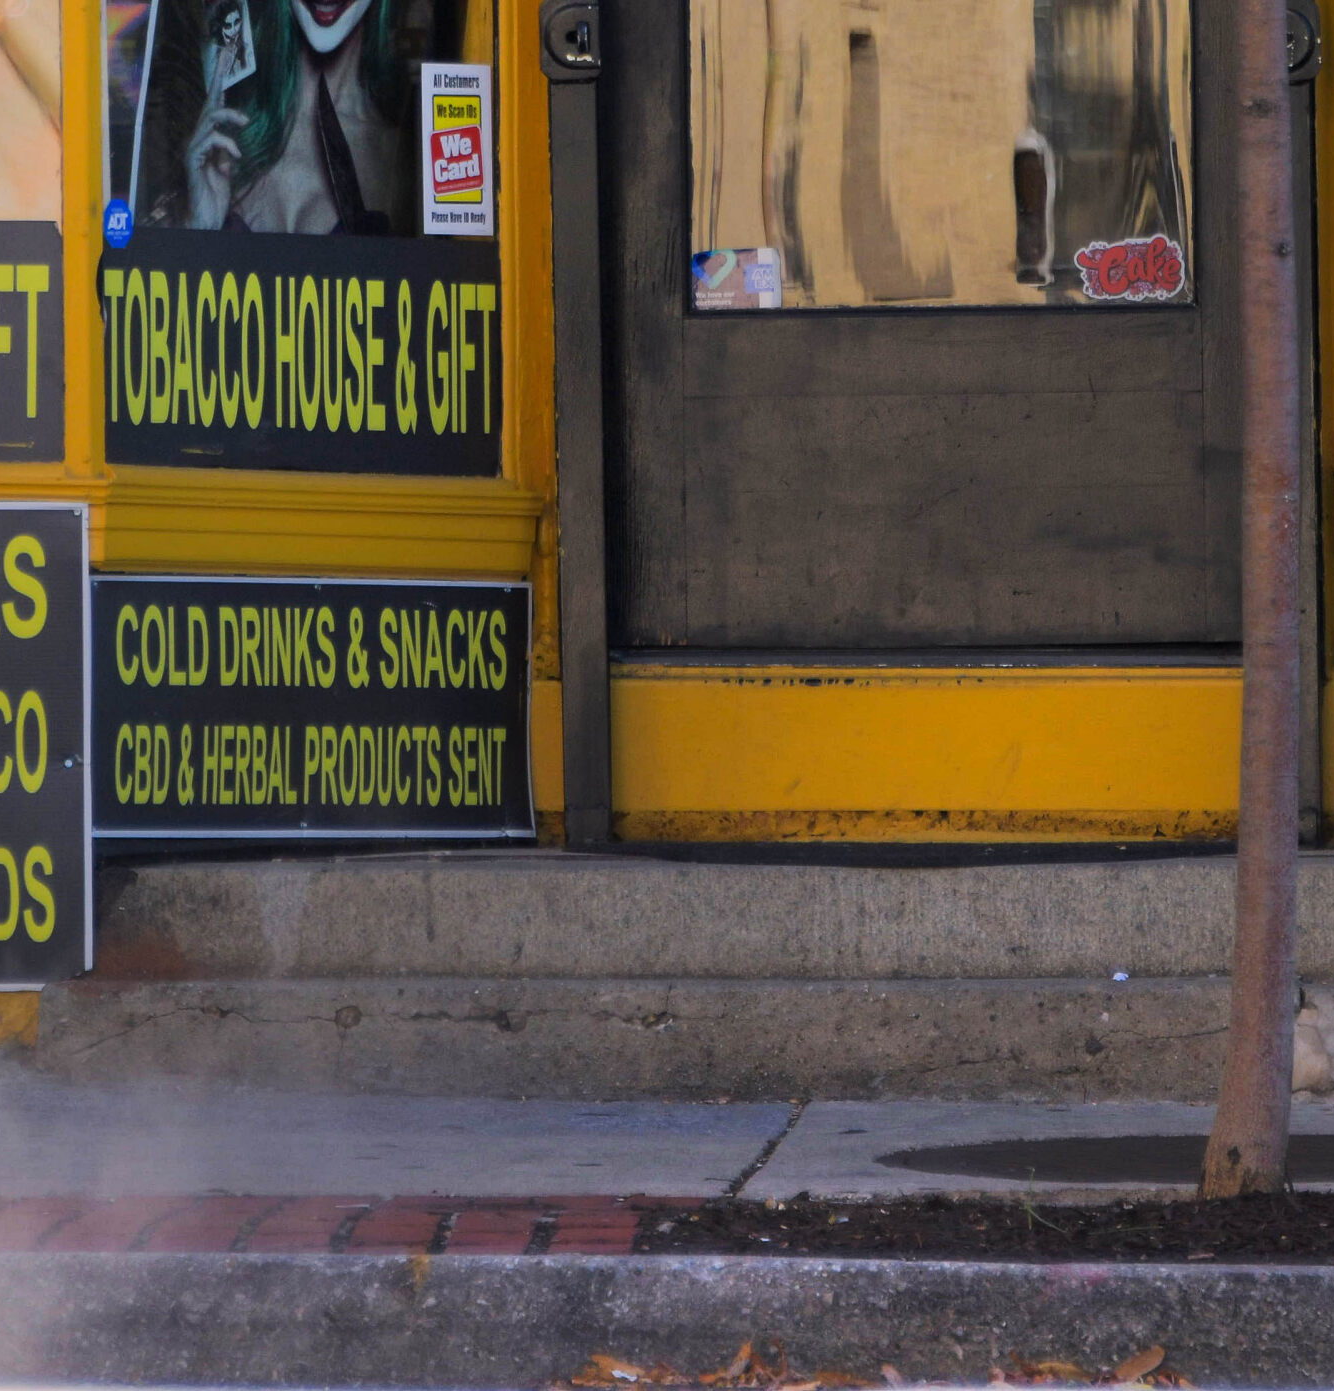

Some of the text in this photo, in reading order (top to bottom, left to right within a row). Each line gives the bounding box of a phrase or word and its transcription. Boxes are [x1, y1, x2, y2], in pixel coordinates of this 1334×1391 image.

[433, 73, 480, 89] All Customers
[436, 104, 447, 118] We
[448, 104, 465, 119] Scan
[440, 133, 472, 159] We
[434, 153, 480, 183] Card
[108, 213, 128, 230] ADT
[431, 211, 449, 224] Please
[470, 212, 486, 226] Ready
[1077, 237, 1182, 294] Cake
[104, 267, 496, 436] TOBACCO HOUSE & GIFT
[116, 604, 508, 692] COLD DRINKS & SNACKS
[114, 724, 507, 808] CBD & HERBAL PRODUCTS SENT
